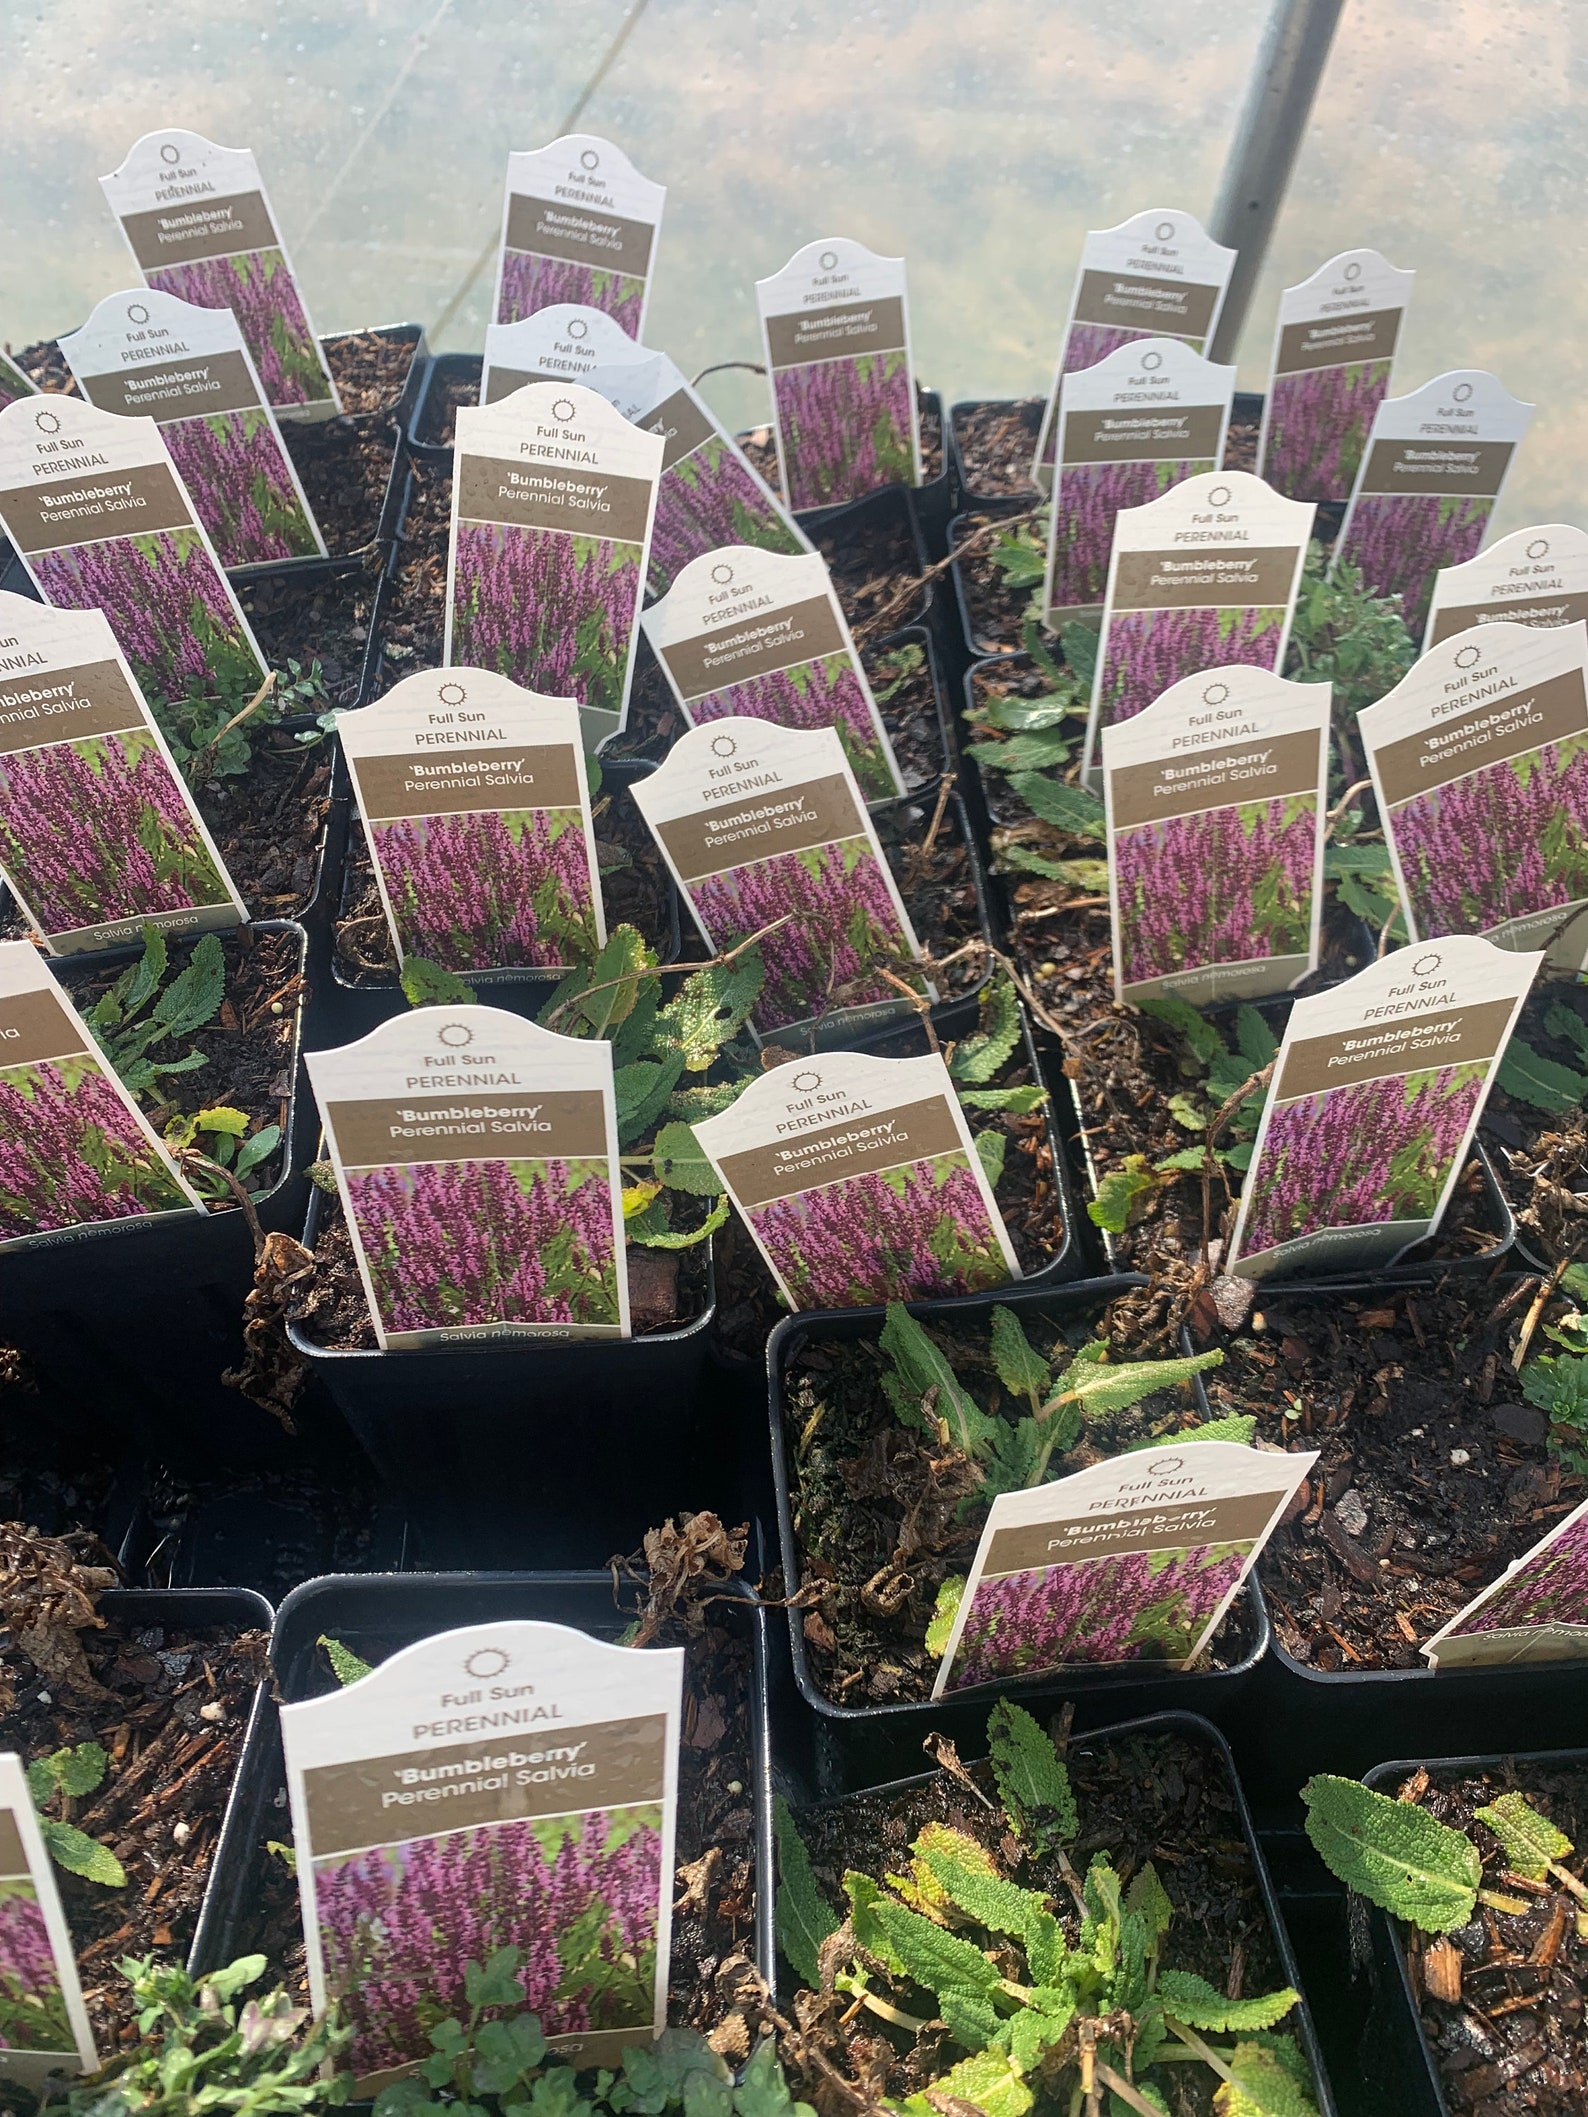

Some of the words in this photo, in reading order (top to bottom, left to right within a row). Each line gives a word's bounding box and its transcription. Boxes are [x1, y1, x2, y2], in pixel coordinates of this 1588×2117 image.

[160, 170, 177, 182] Full
[178, 168, 197, 179] Sun
[155, 181, 216, 201] PERENNIAL
[157, 205, 232, 230] 'Bumbleberry'
[158, 224, 209, 243] Perennial
[209, 220, 244, 234] Salvia
[126, 332, 146, 342] Full
[147, 328, 169, 339] Sun
[121, 341, 190, 362] PERENNIAL
[553, 342, 573, 353] Full
[575, 346, 595, 357] Sun
[124, 366, 209, 391] 'Bumbleberry'
[125, 386, 181, 404] Perennial
[183, 380, 221, 394] Salvia
[537, 426, 558, 438] Full
[562, 430, 586, 442] Sun
[36, 443, 59, 454] Full
[60, 439, 85, 450] Sun
[520, 443, 599, 464] PERENNIAL
[32, 453, 109, 476] PERENNIAL
[39, 481, 132, 507] 'Bumbleberry'
[507, 472, 608, 499] 'Bumbleberry'
[40, 503, 104, 523] Perennial
[105, 497, 147, 512] Salvia
[498, 486, 567, 505] Perennial
[568, 496, 611, 512] Salvia
[1192, 514, 1213, 524] Full
[1216, 514, 1239, 523] Sun
[1174, 530, 1249, 542] PERENNIAL
[1160, 558, 1258, 571] 'Bumbleberry'
[1151, 573, 1215, 585] Perennial
[1216, 572, 1259, 583] Salvia
[1491, 578, 1563, 596] PERENNIAL
[708, 591, 729, 605] Full
[730, 584, 753, 597] Sun
[702, 595, 774, 626] PERENNIAL
[0, 637, 20, 648] un
[704, 616, 793, 653] 'Bumbleberry'
[703, 642, 764, 669] Perennial
[764, 630, 805, 649] Salvia
[1444, 676, 1468, 693] Full
[1471, 666, 1498, 682] Sun
[41, 698, 92, 716] Salvia
[1431, 676, 1519, 718] PERENNIAL
[428, 713, 454, 724] Full
[458, 712, 486, 723] Sun
[1188, 713, 1212, 726] Full
[1215, 709, 1243, 721] Sun
[1424, 698, 1536, 749] 'Bumbleberry'
[415, 729, 508, 745] PERENNIAL
[1172, 722, 1260, 749] PERENNIAL
[1419, 731, 1492, 768] Perennial
[1494, 711, 1544, 737] Salvia
[408, 758, 526, 776] 'Bumbleberry'
[708, 765, 732, 779] Full
[733, 759, 760, 772] Sun
[1160, 749, 1273, 781] 'Bumbleberry'
[404, 776, 481, 791] Perennial
[485, 773, 535, 785] Salvia
[702, 771, 784, 801] PERENNIAL
[1153, 773, 1226, 797] Perennial
[1229, 764, 1278, 781] Salvia
[704, 796, 806, 832] 'Bumbleberry'
[704, 820, 773, 848] Perennial
[773, 810, 819, 829] Salvia
[94, 927, 134, 941] Salvia
[135, 915, 199, 934] nmorosa
[1387, 983, 1416, 998] Full
[1418, 979, 1447, 992] Sun
[1363, 992, 1457, 1021] PERENNIAL
[1342, 1017, 1464, 1051] 'Bumbleberry'
[424, 1055, 456, 1067] Full
[461, 1054, 497, 1065] Sun
[1327, 1041, 1407, 1068] Perennial
[1409, 1032, 1462, 1051] Salvia
[405, 1072, 523, 1089] PERENNIAL
[396, 1104, 544, 1122] 'Bumbleberry'
[785, 1098, 814, 1113] Full
[816, 1090, 847, 1104] Sun
[775, 1099, 874, 1134] PERENNIAL
[389, 1121, 486, 1138] Perennial
[489, 1120, 553, 1133] Salvia
[774, 1119, 897, 1162] 'Bumbleberry'
[772, 1145, 854, 1176] Perennial
[855, 1131, 910, 1153] Salvia
[28, 1235, 75, 1249] Salvia
[78, 1220, 153, 1240] nemorosa
[440, 1331, 488, 1342] Salvia
[491, 1330, 571, 1340] nemorosa
[1118, 1481, 1153, 1493] Full
[1157, 1477, 1194, 1488] Sun
[1088, 1487, 1209, 1511] PERENNIAL
[1047, 1526, 1146, 1551] Perennial
[1151, 1519, 1218, 1535] Salvia
[1482, 1630, 1531, 1641] Salvia
[441, 1690, 482, 1707] Full
[488, 1684, 535, 1701] Sun
[412, 1703, 565, 1740] PERENNIAL
[393, 1741, 589, 1786] 'Bumbleberry'
[381, 1773, 510, 1809] Perennial
[514, 1762, 597, 1786] Salvia
